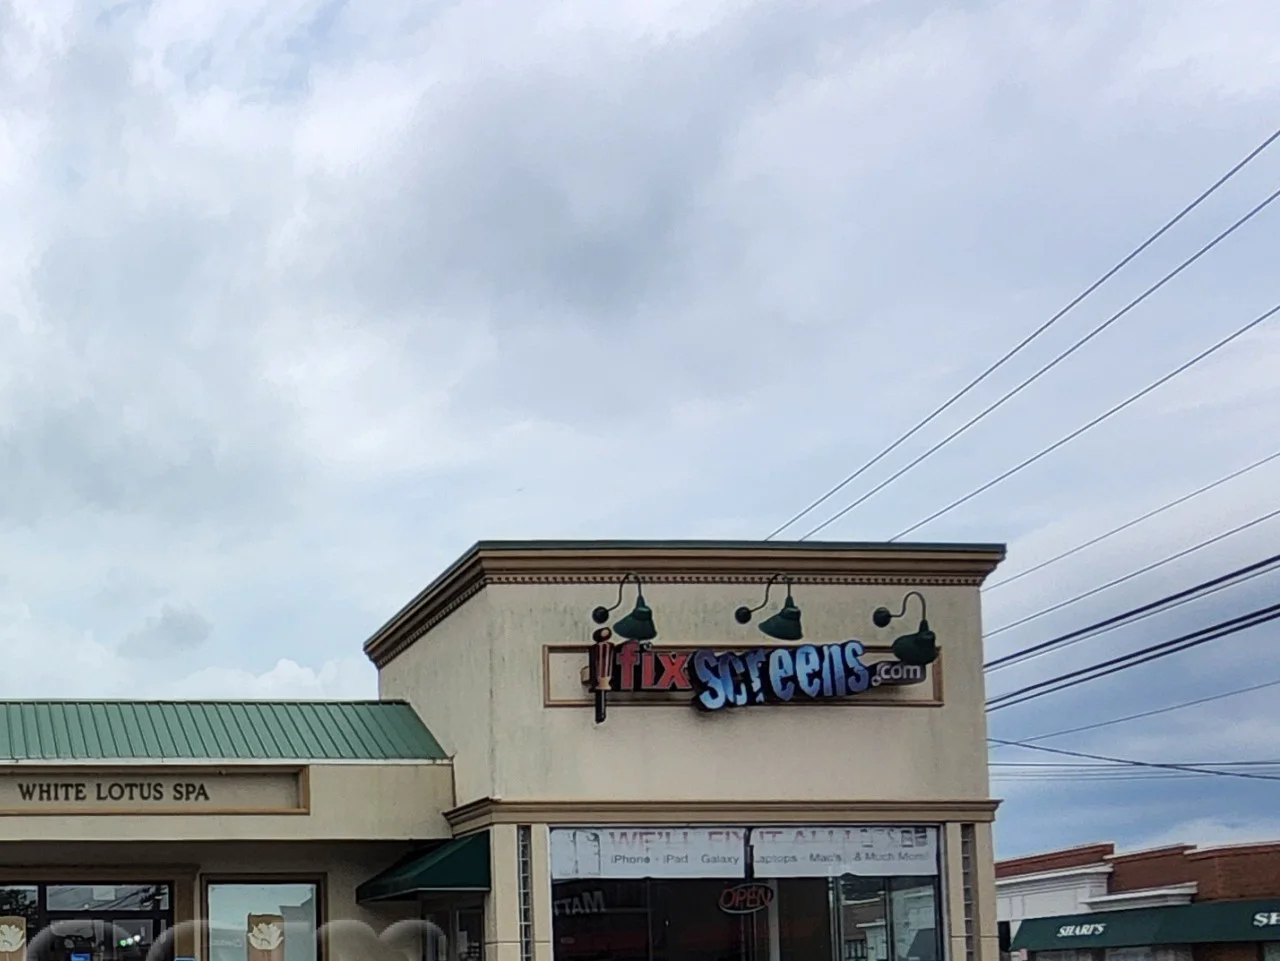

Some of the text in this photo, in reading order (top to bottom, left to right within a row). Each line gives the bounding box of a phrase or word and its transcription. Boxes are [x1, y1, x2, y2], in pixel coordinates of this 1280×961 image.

[18, 783, 210, 801] WHITE LOTUS SPA
[611, 854, 650, 864] iPhone
[663, 853, 689, 864] iPad
[701, 853, 740, 866] Galaxy
[720, 887, 772, 908] OPEN
